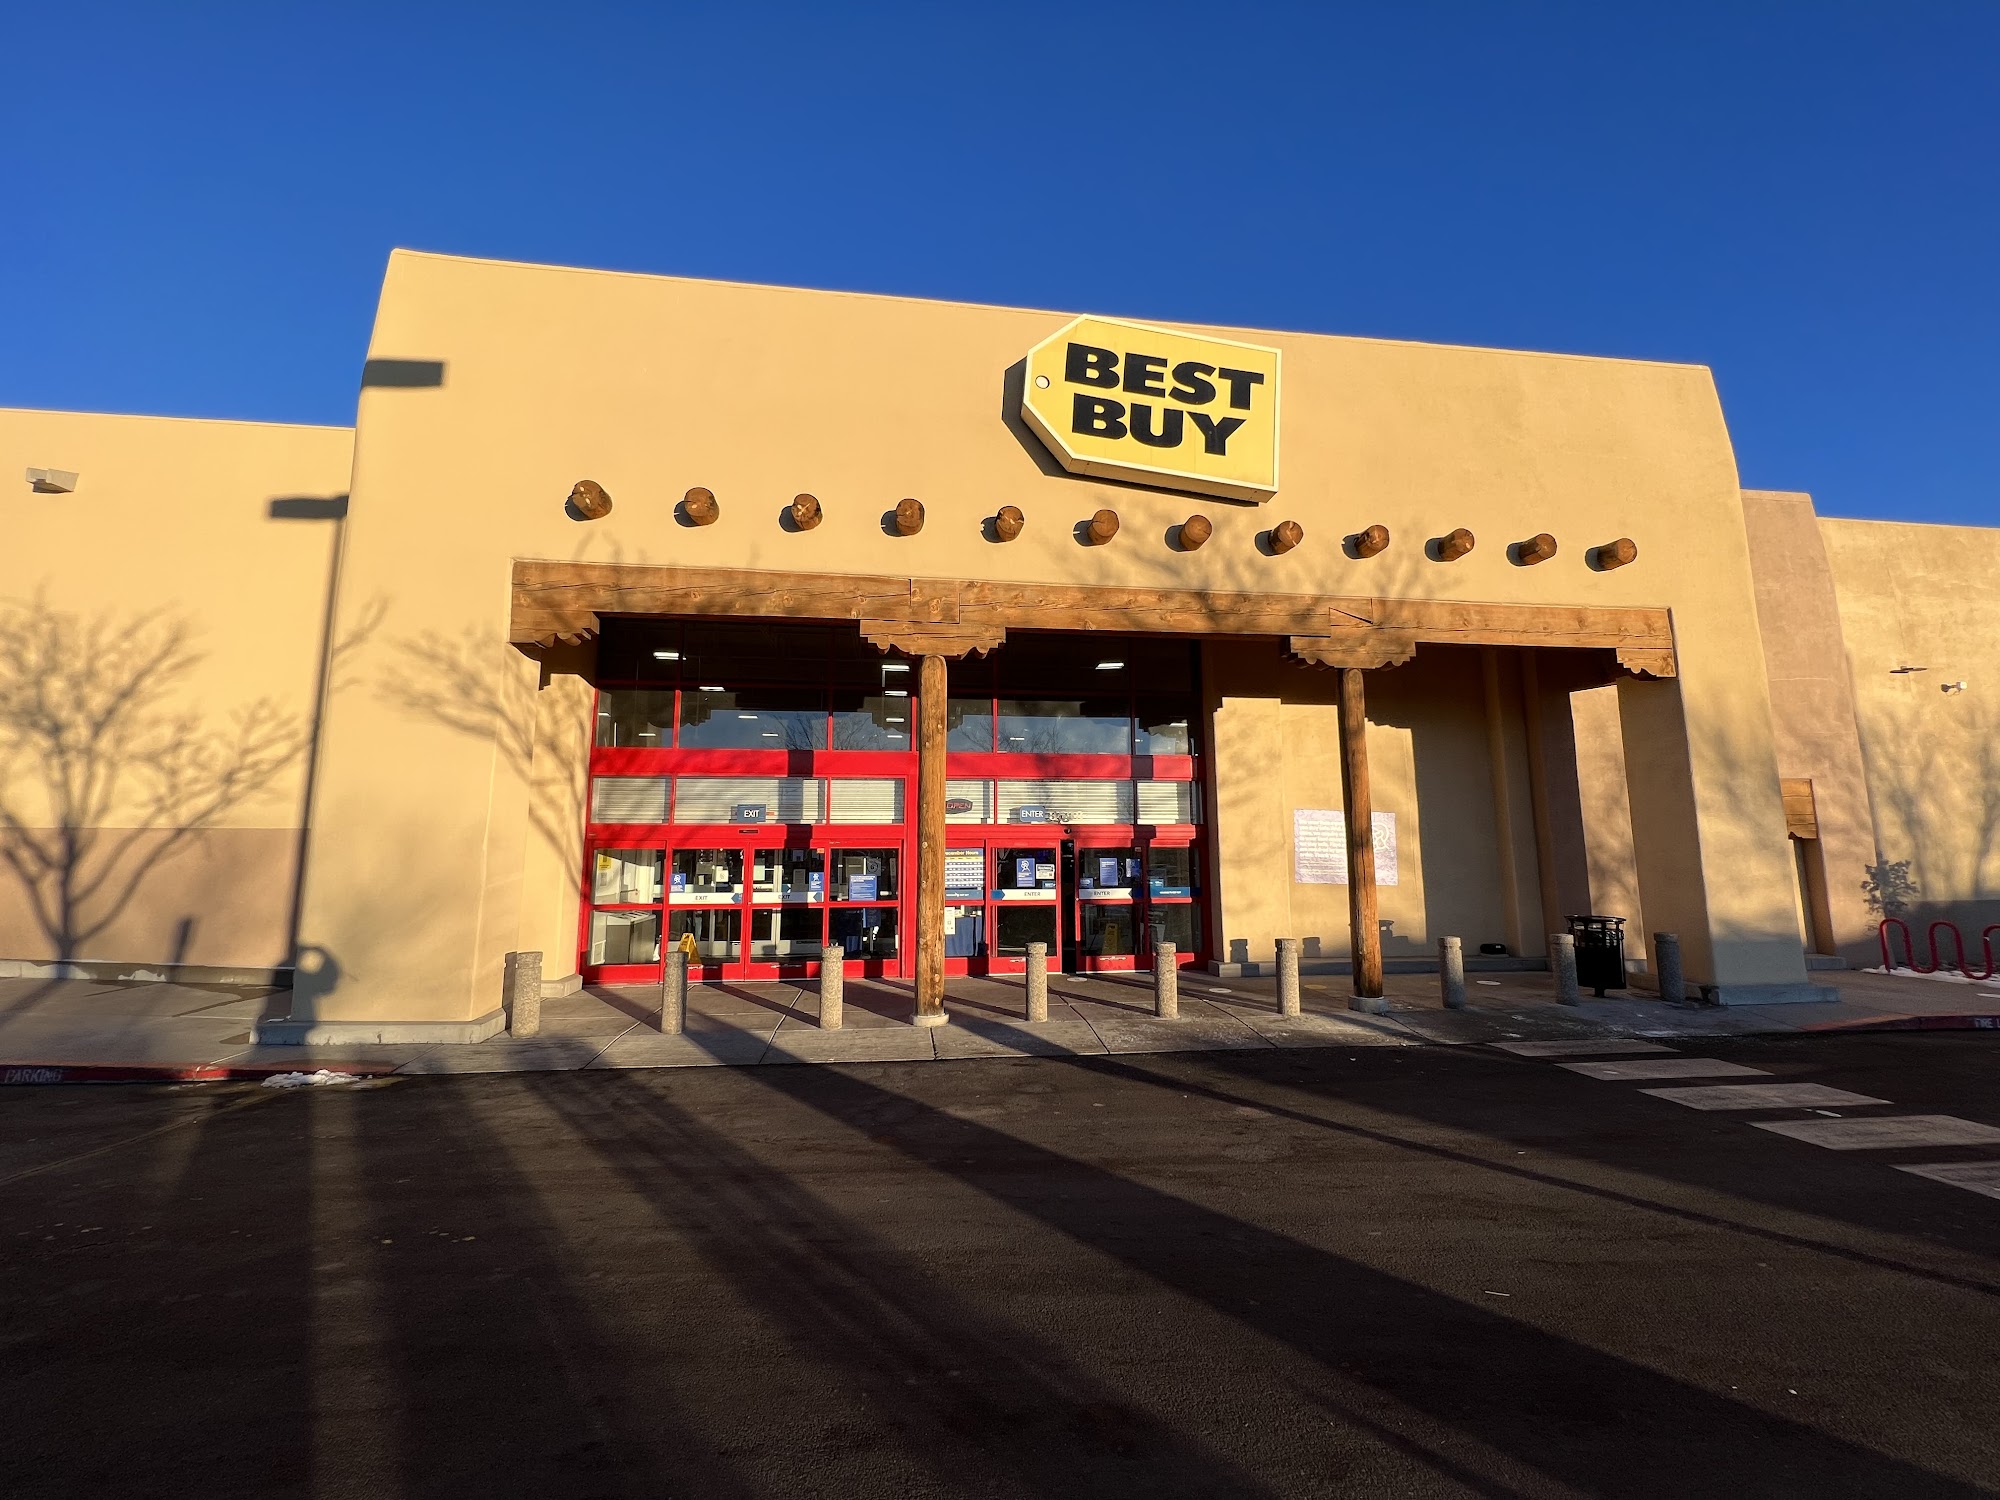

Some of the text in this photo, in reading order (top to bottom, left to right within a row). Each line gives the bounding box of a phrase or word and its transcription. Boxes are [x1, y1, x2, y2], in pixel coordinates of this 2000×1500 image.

[1065, 342, 1264, 411] BEST
[1072, 393, 1247, 456] BUY
[743, 809, 760, 818] EXIT
[1021, 809, 1044, 818] ENTER
[1974, 1017, 1994, 1029] FIRE
[4, 1068, 63, 1083] PARKING
